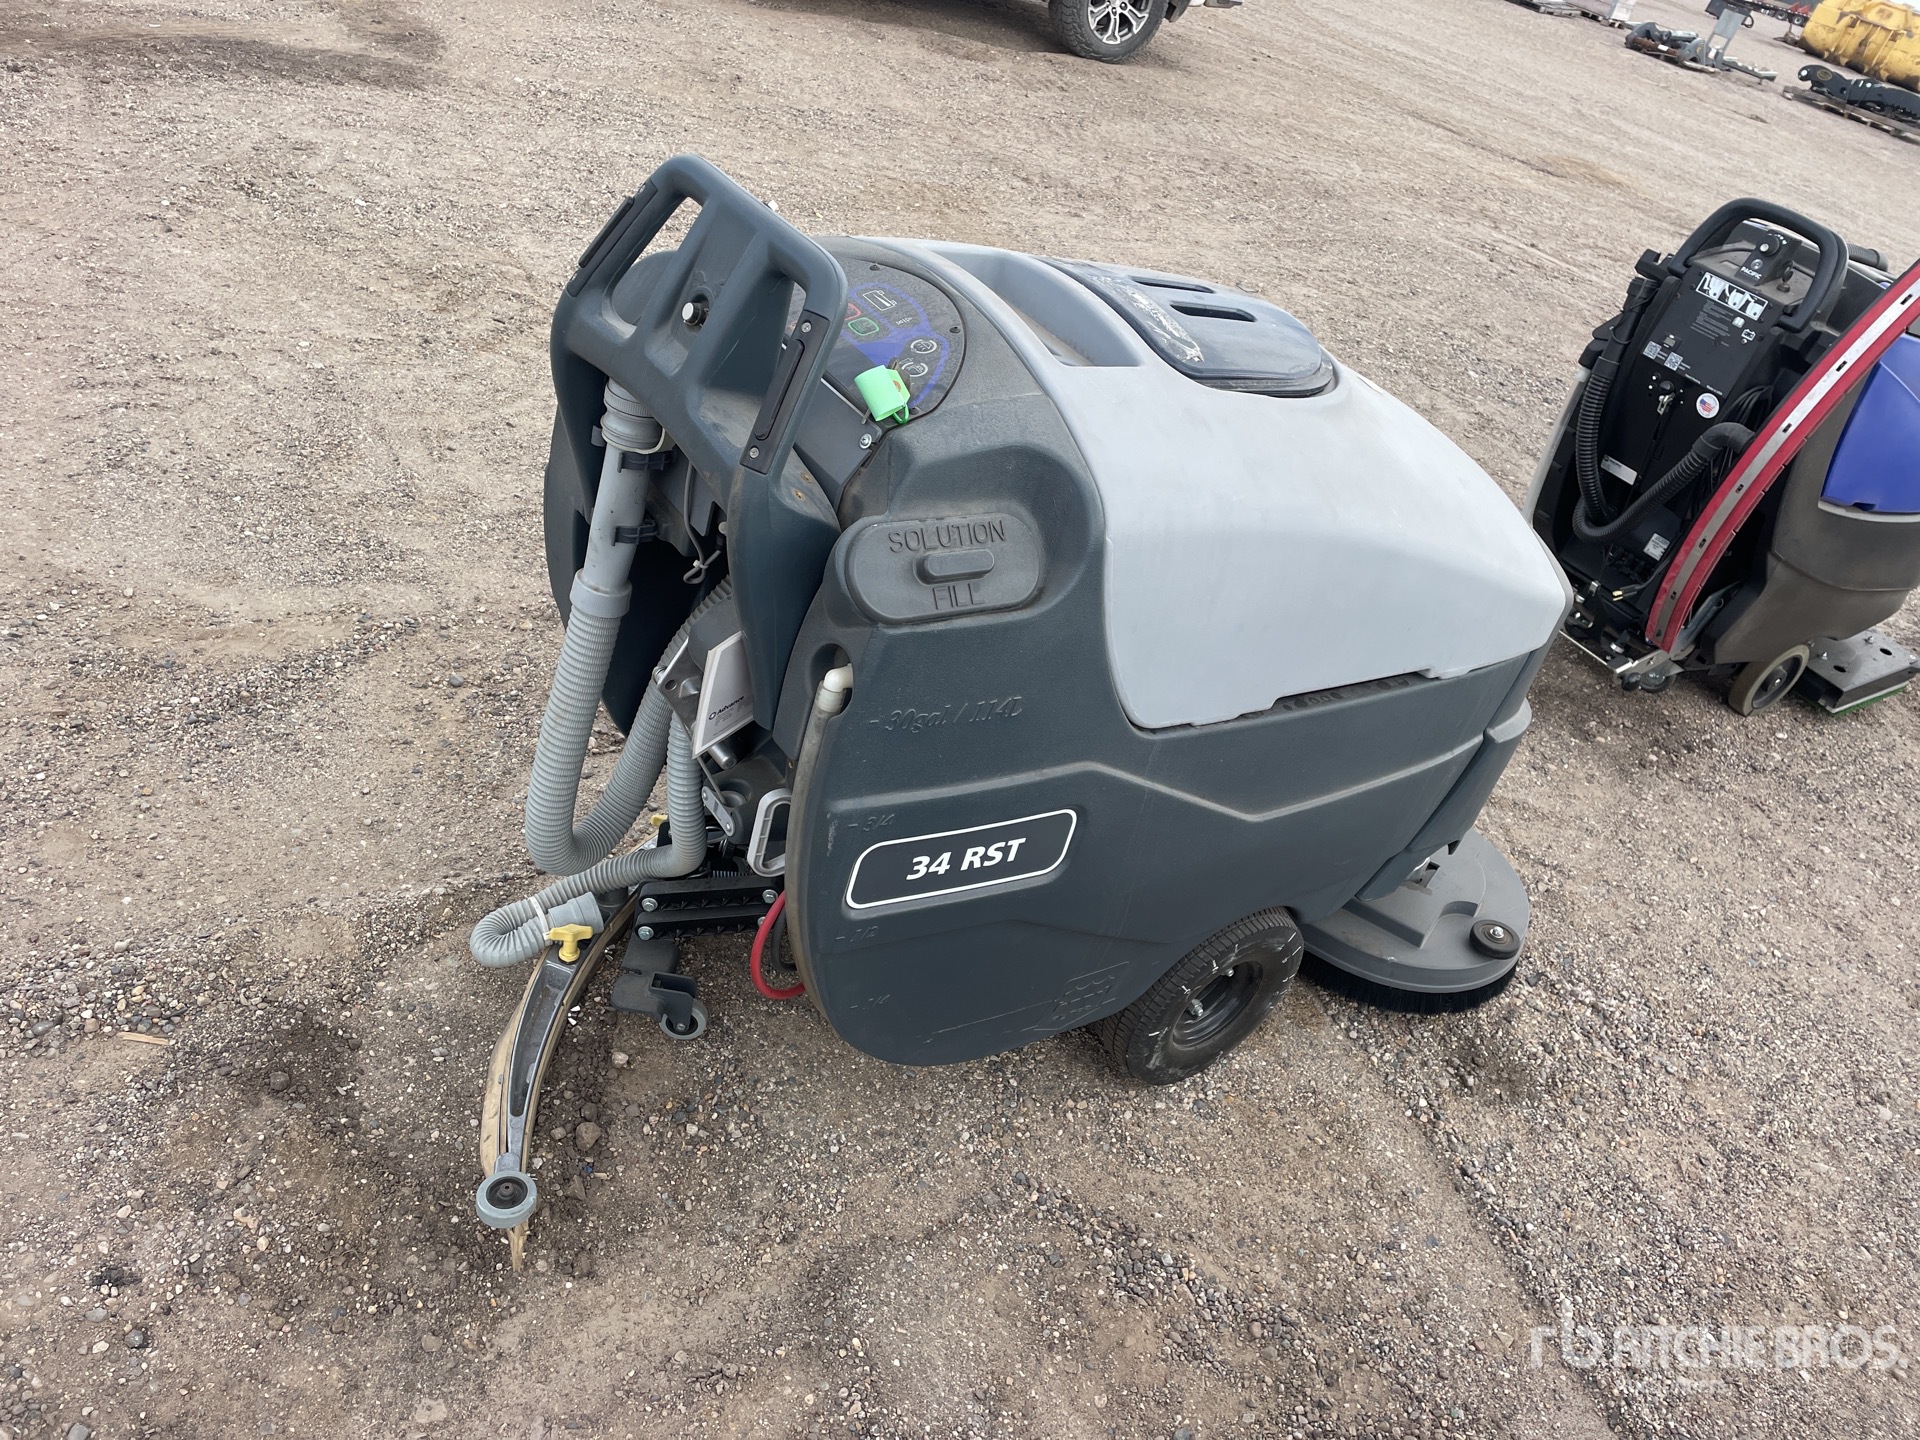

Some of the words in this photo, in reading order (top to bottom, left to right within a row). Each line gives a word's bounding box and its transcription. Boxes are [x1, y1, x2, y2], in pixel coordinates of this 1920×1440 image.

[888, 520, 1006, 554] SOLUTION
[932, 583, 985, 610] FILL
[716, 696, 745, 715] Advance
[906, 852, 952, 881] 34
[960, 837, 1027, 871] RST
